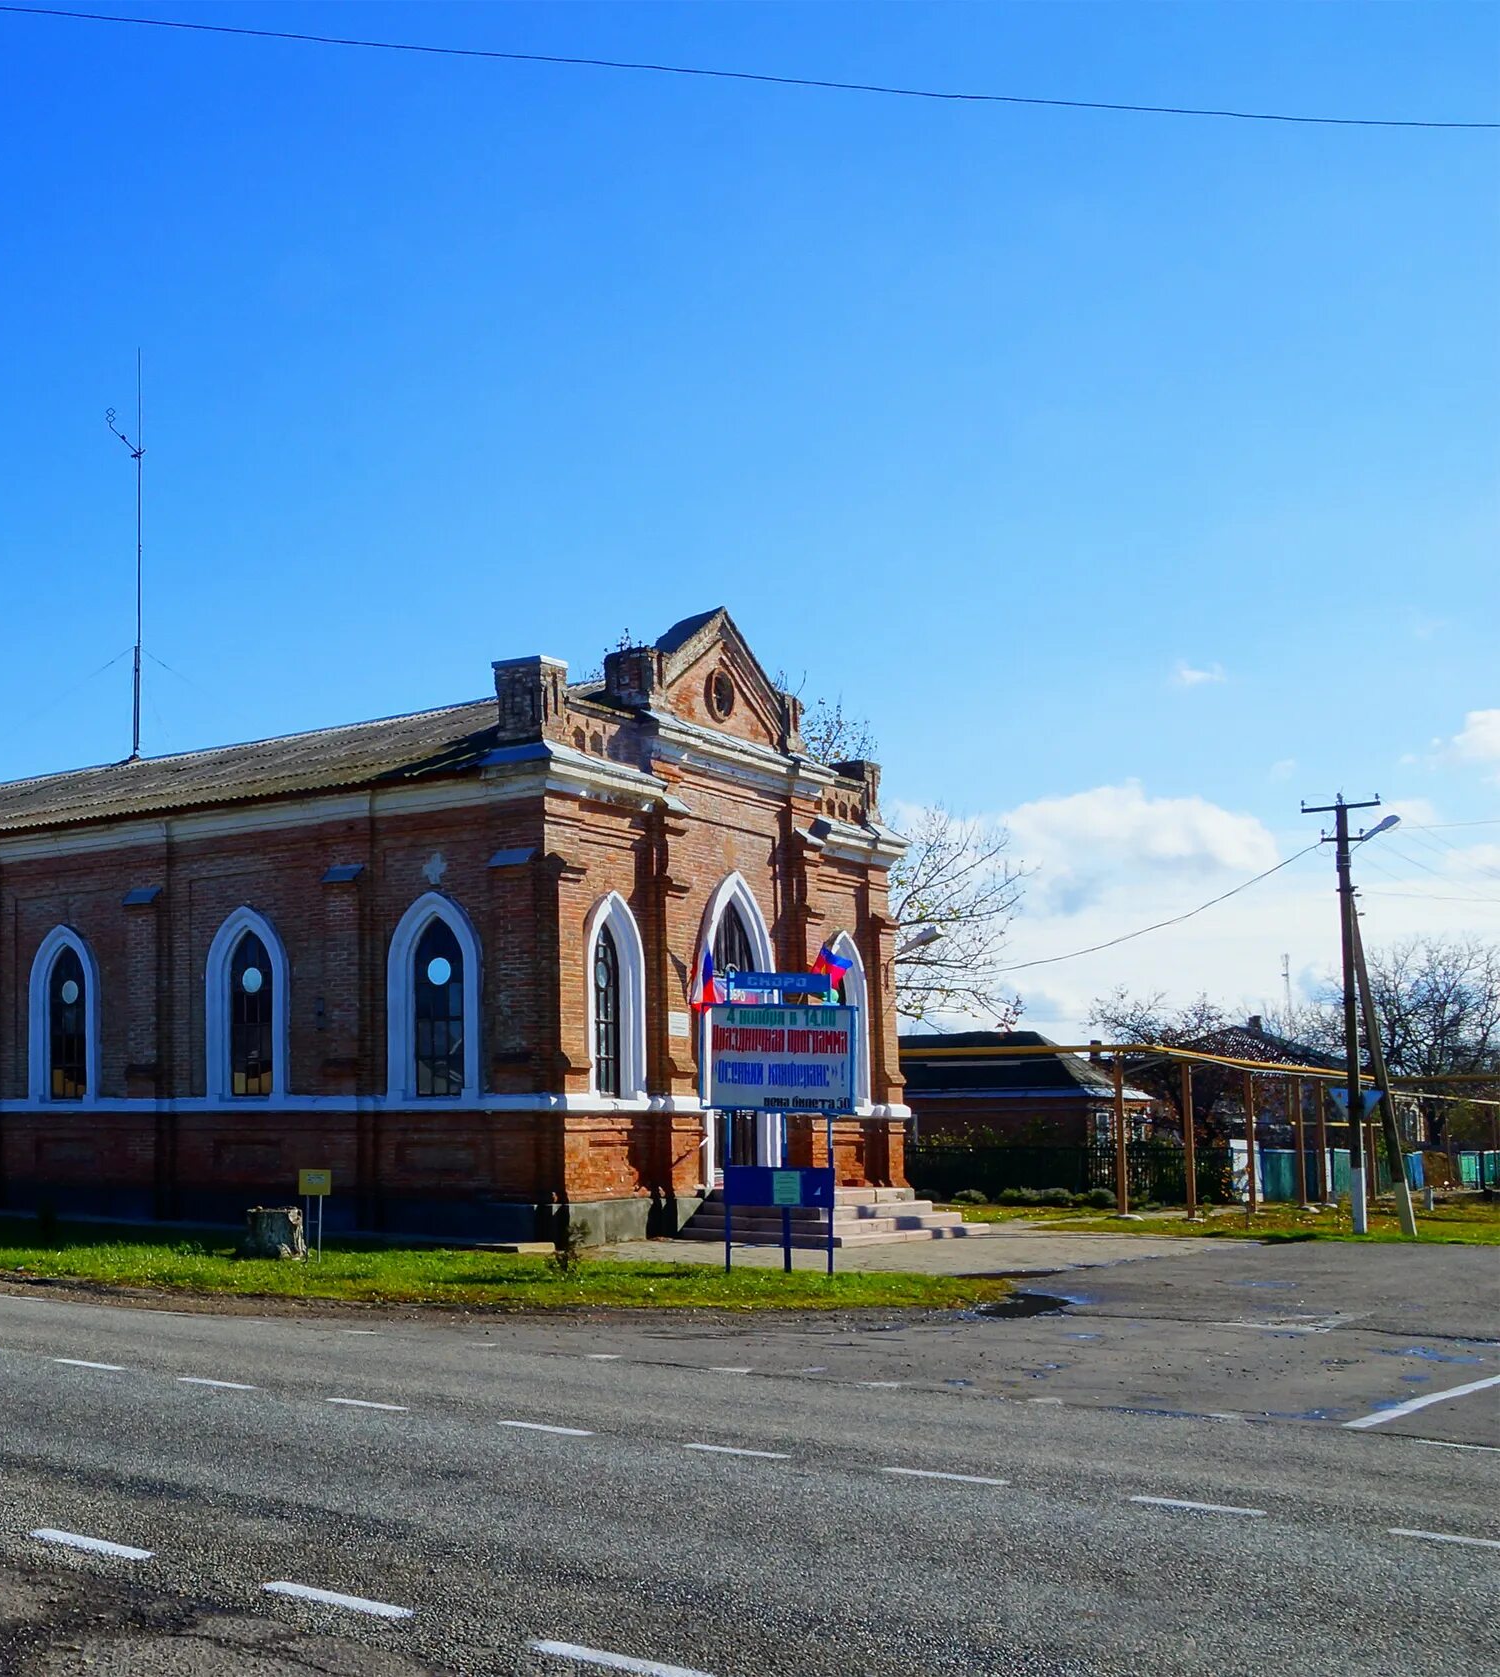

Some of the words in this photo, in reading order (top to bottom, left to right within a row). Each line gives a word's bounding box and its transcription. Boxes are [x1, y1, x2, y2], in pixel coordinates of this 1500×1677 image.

[747, 976, 808, 988] СКОРО
[726, 1007, 735, 1024] 4
[739, 1008, 785, 1026] ноября
[712, 1024, 785, 1052] Праздничная
[787, 1029, 848, 1055] программа
[763, 1097, 790, 1107] цена
[792, 1096, 835, 1109] билета
